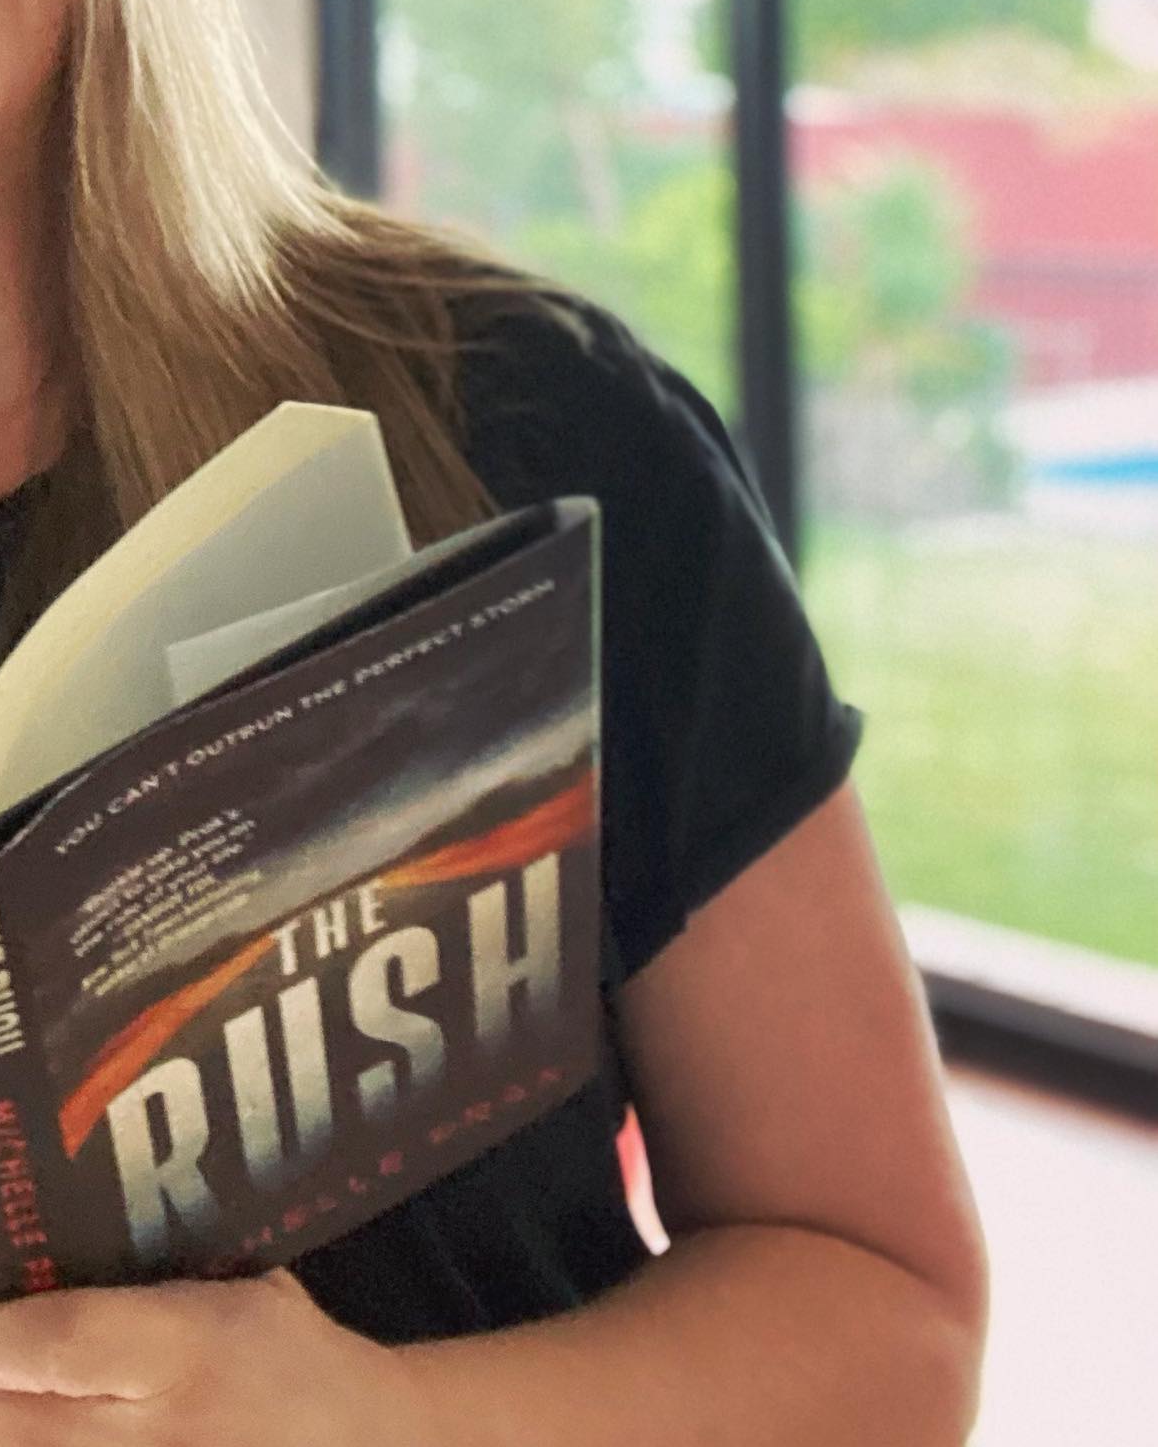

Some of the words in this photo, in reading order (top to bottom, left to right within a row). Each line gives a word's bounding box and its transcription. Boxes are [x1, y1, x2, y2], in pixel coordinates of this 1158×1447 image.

[54, 812, 103, 854] YOU
[185, 705, 293, 768] OUTRUN
[298, 678, 346, 709] THE
[353, 621, 464, 685] PERFECT
[469, 579, 556, 629] STORM
[106, 851, 562, 1260] RUSH
[271, 877, 388, 977] THE
